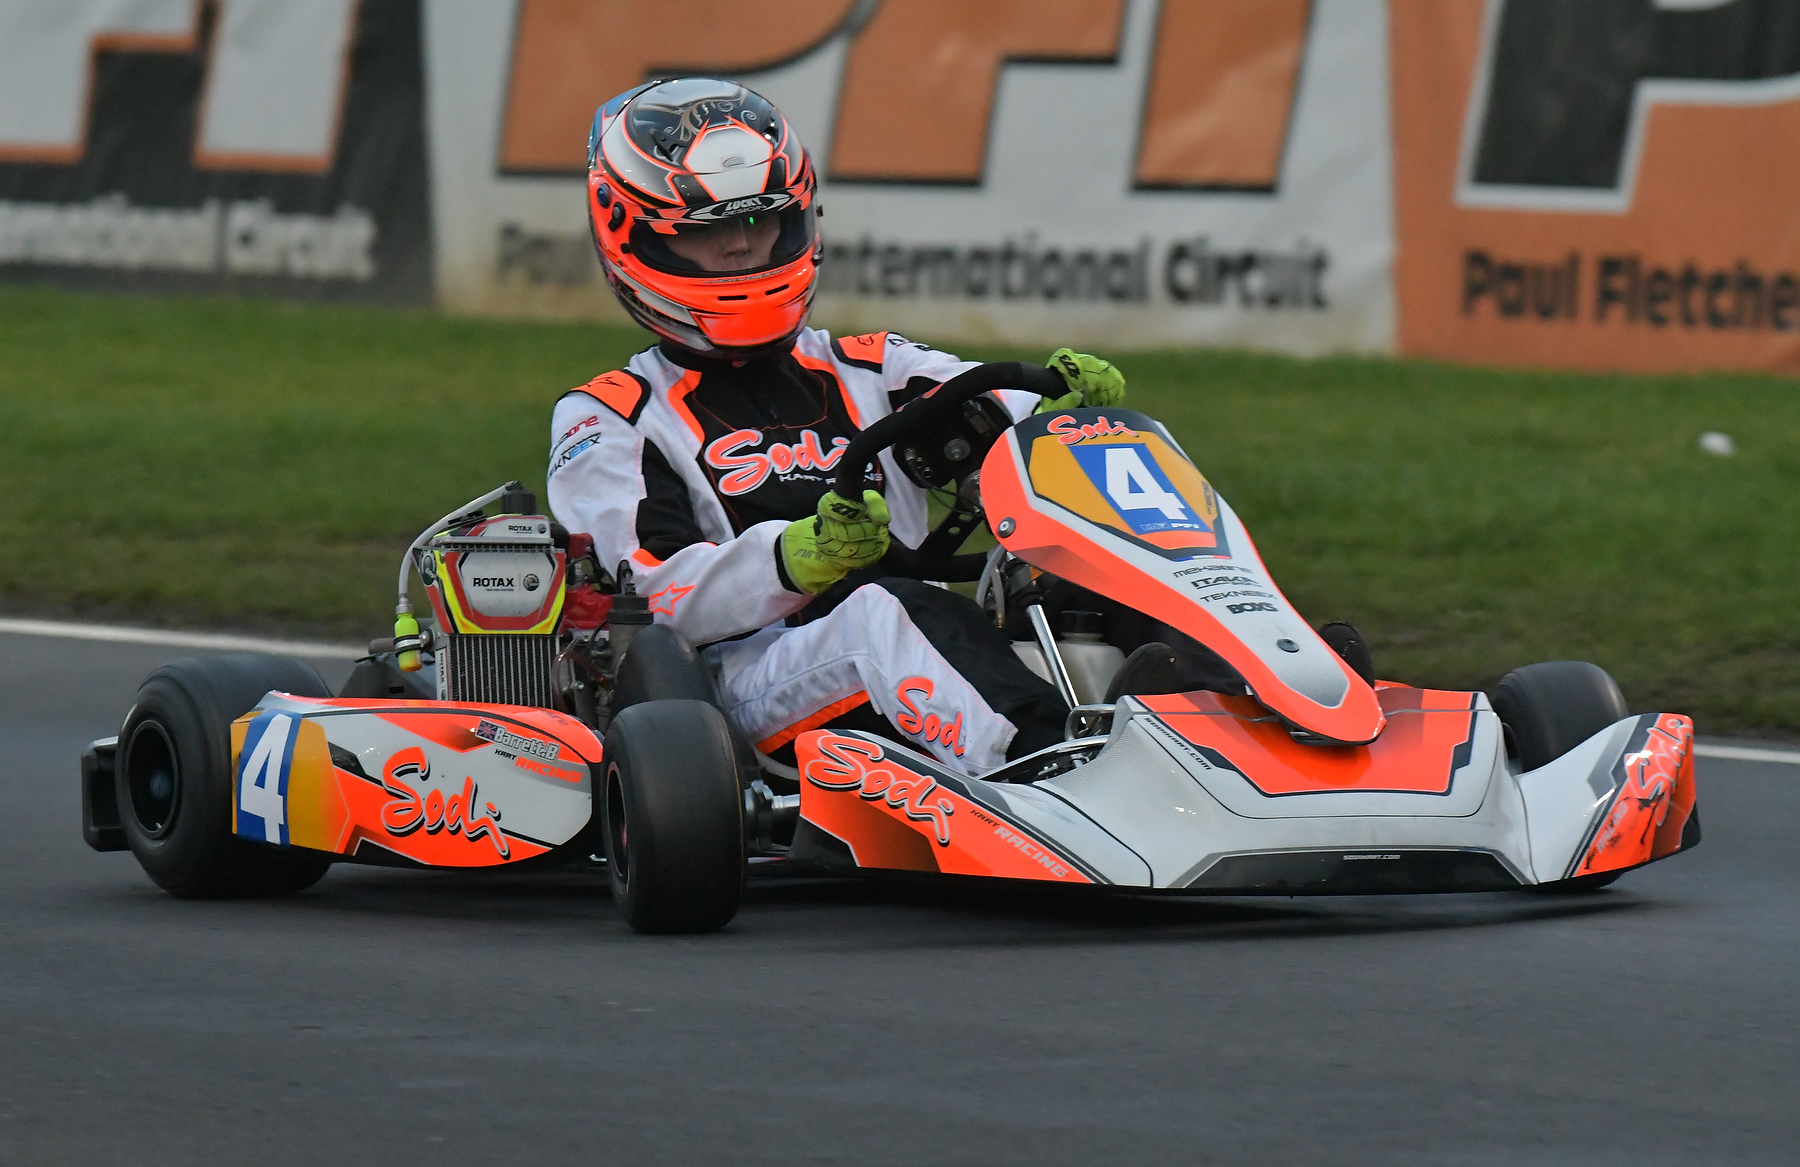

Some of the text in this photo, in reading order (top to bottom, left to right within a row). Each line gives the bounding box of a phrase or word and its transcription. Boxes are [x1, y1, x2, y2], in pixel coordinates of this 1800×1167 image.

[725, 197, 762, 211] LUCKY
[498, 220, 1328, 310] Pau nternational Circuit
[1462, 249, 1581, 323] Paul
[1046, 415, 1139, 445] Sodi
[1105, 447, 1189, 521] 4
[473, 577, 515, 587] ROTAX
[493, 726, 560, 762] Barrett.B
[896, 676, 966, 759] Sod
[240, 713, 293, 846] 4
[381, 745, 511, 860] Sodi
[495, 748, 584, 783] KART RACING
[805, 734, 954, 848] Sodi
[970, 809, 1069, 878] KART RACING
